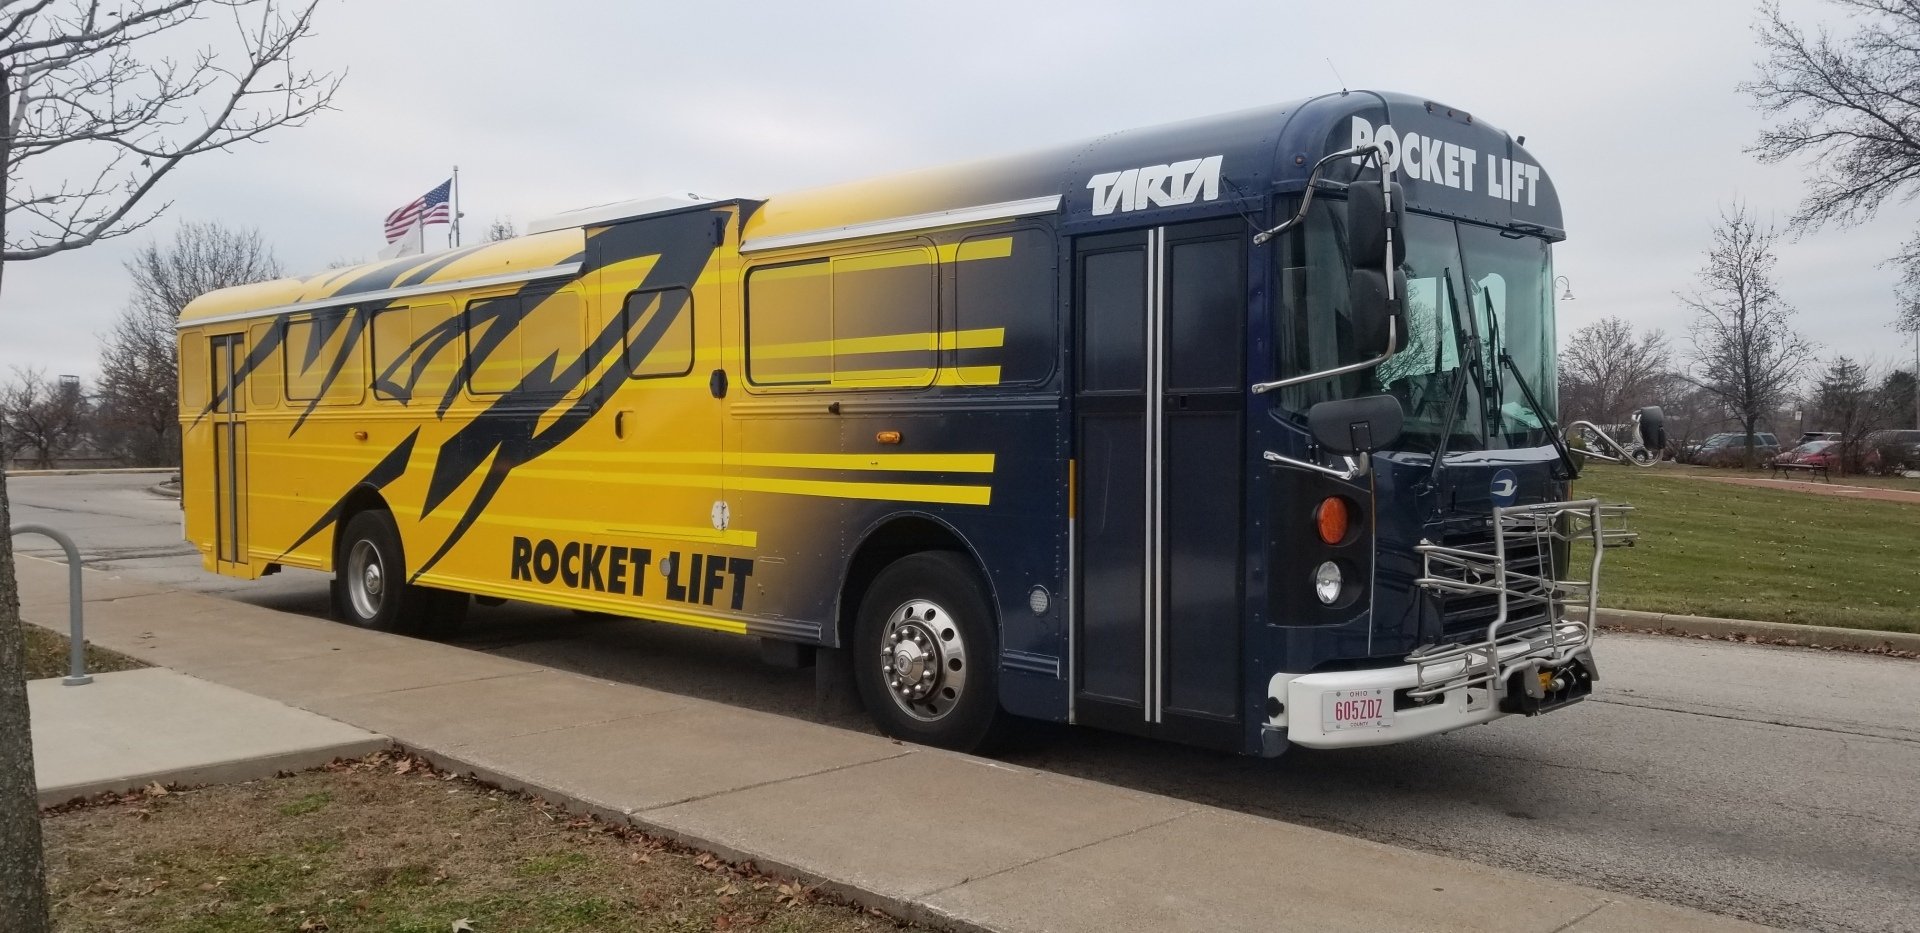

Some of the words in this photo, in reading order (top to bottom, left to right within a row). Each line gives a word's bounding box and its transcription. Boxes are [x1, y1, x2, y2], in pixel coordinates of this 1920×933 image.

[1086, 154, 1224, 217] TARTA
[1351, 115, 1477, 192] ROCKET
[1487, 153, 1540, 207] LIFT
[510, 535, 652, 597] ROCKET
[665, 550, 755, 611] LIFT
[1335, 698, 1383, 721] 605ZDZ
[1349, 690, 1368, 698] OHIO
